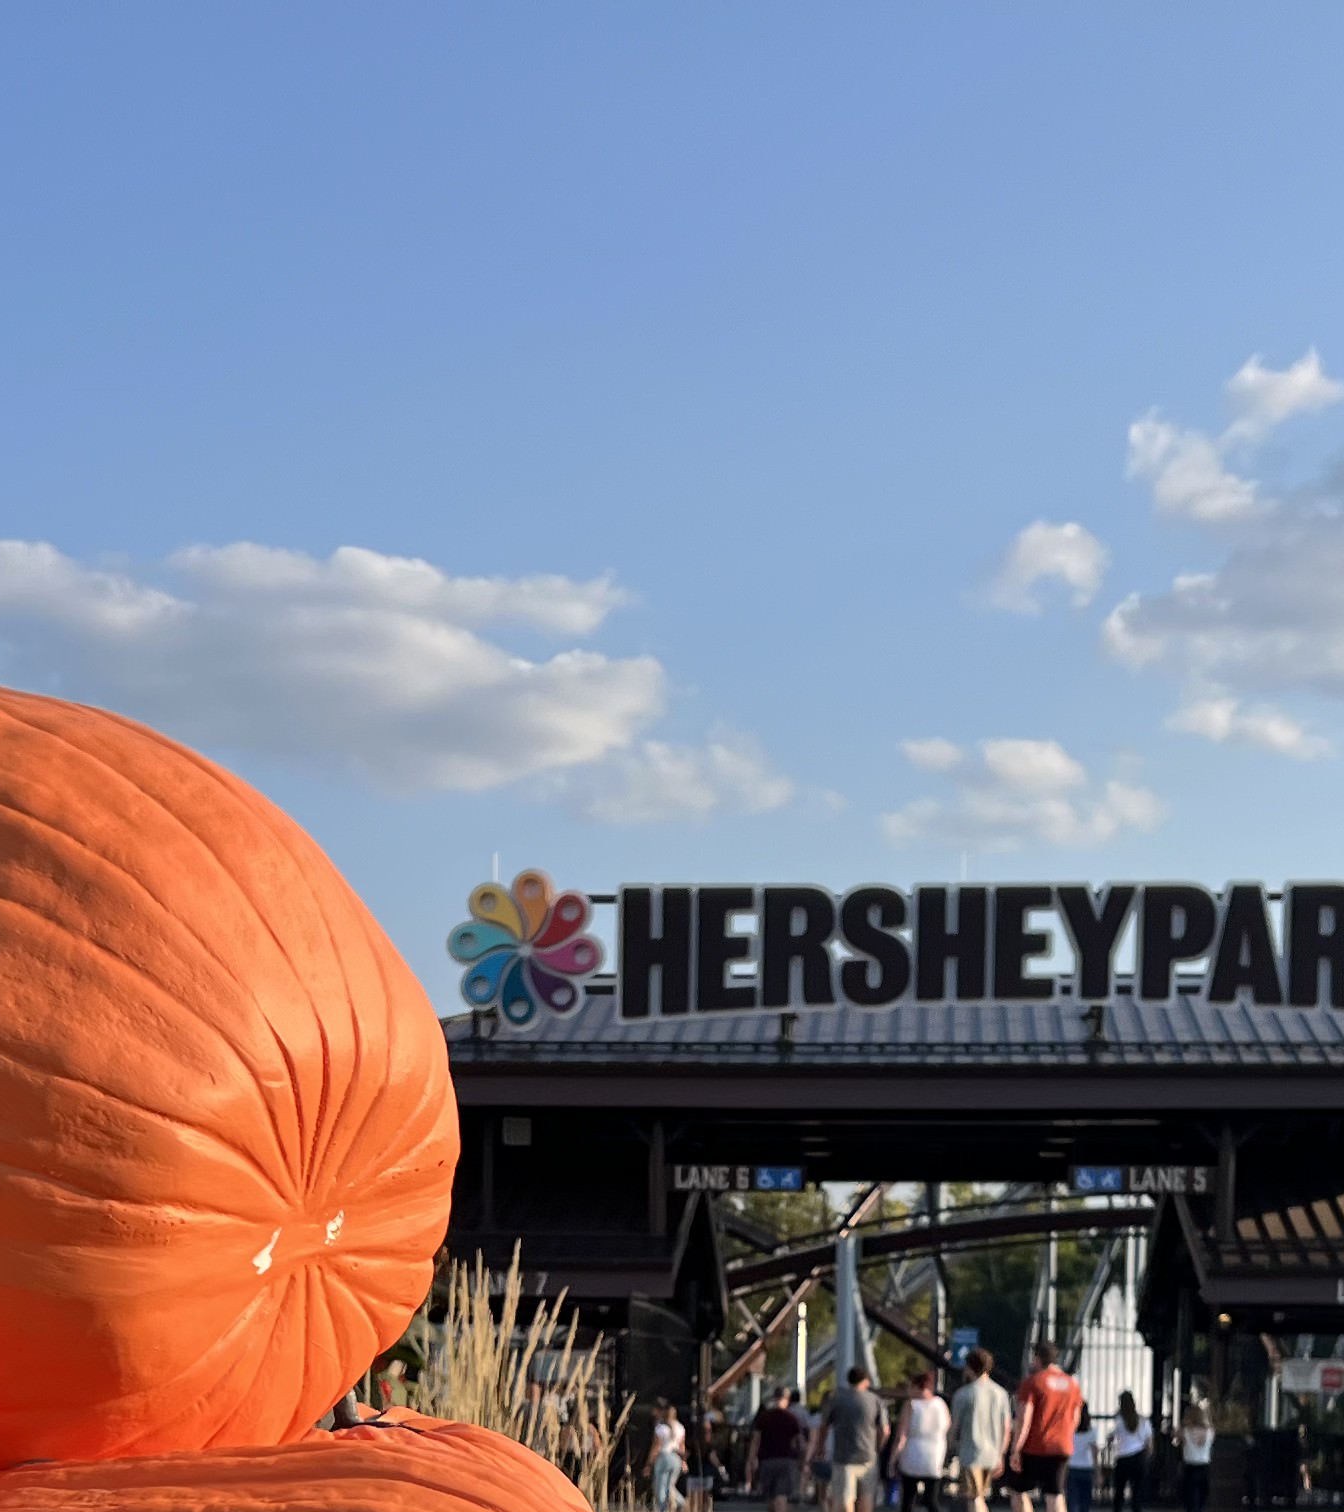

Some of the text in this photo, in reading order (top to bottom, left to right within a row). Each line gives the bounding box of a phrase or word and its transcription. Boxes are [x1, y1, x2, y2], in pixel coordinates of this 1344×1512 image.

[674, 1165, 750, 1189] LANE 6
[1129, 1166, 1207, 1192] LANE 5
